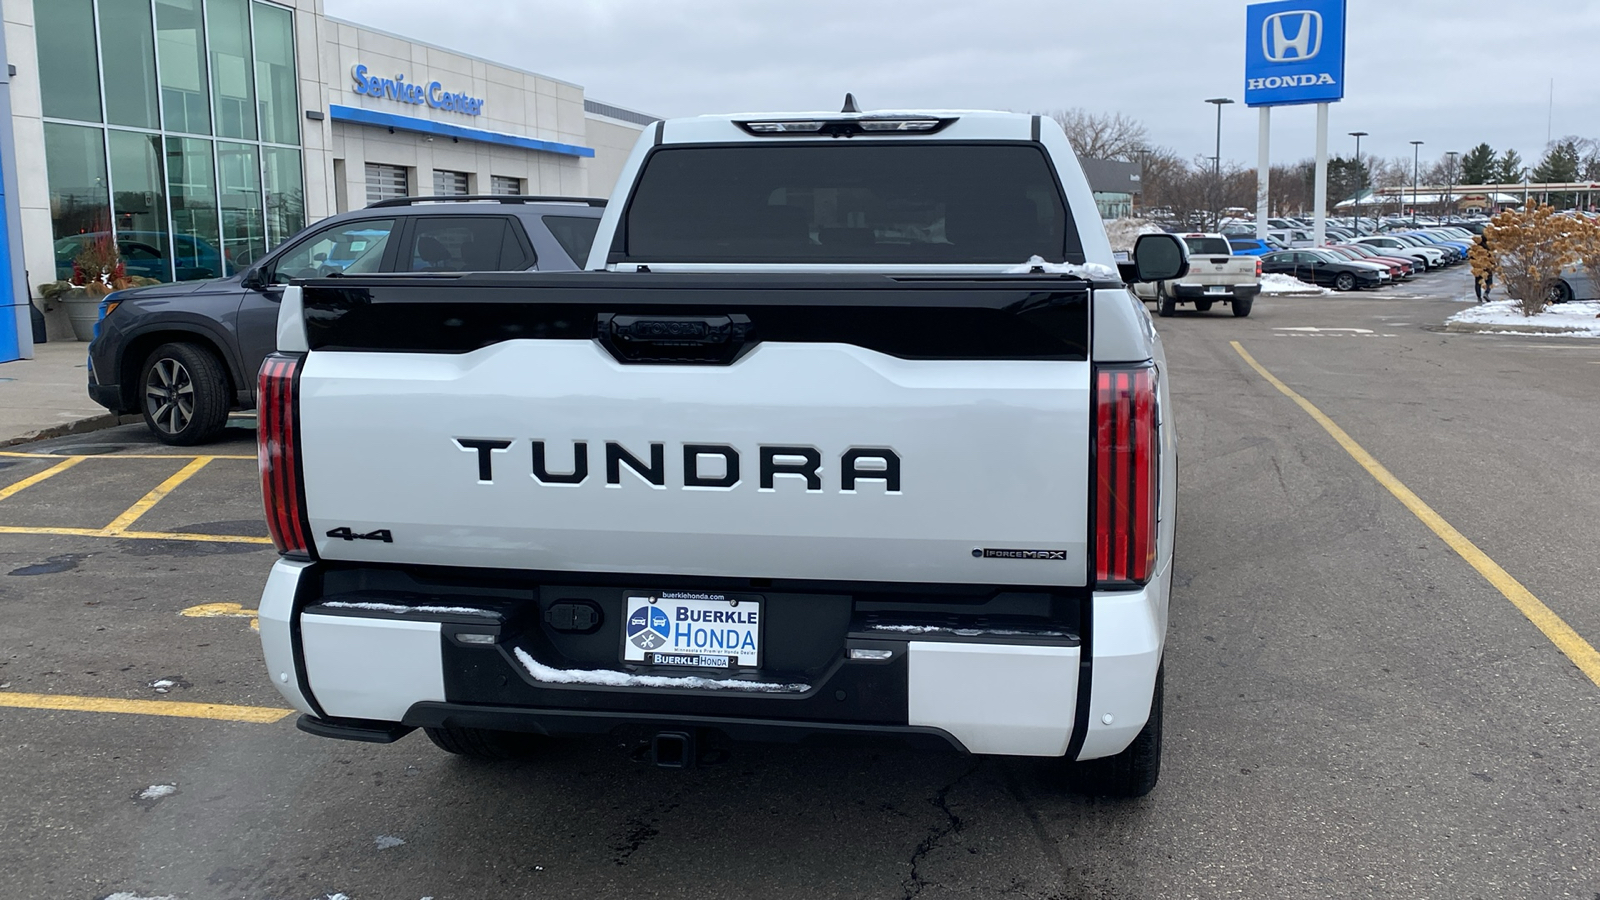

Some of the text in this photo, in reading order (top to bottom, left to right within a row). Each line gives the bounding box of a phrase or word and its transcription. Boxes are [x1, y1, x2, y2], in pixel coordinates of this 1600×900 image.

[351, 64, 483, 116] Service Center
[1247, 72, 1337, 90] HONDA
[643, 322, 700, 335] TOYOTA
[450, 436, 903, 495] TUNDRA
[326, 526, 393, 543] 4x4
[662, 591, 725, 600] buerklehonda.com
[676, 606, 758, 624] BUERKLE
[674, 622, 756, 650] HONDA
[654, 654, 727, 667] BUERKLE HONDA
